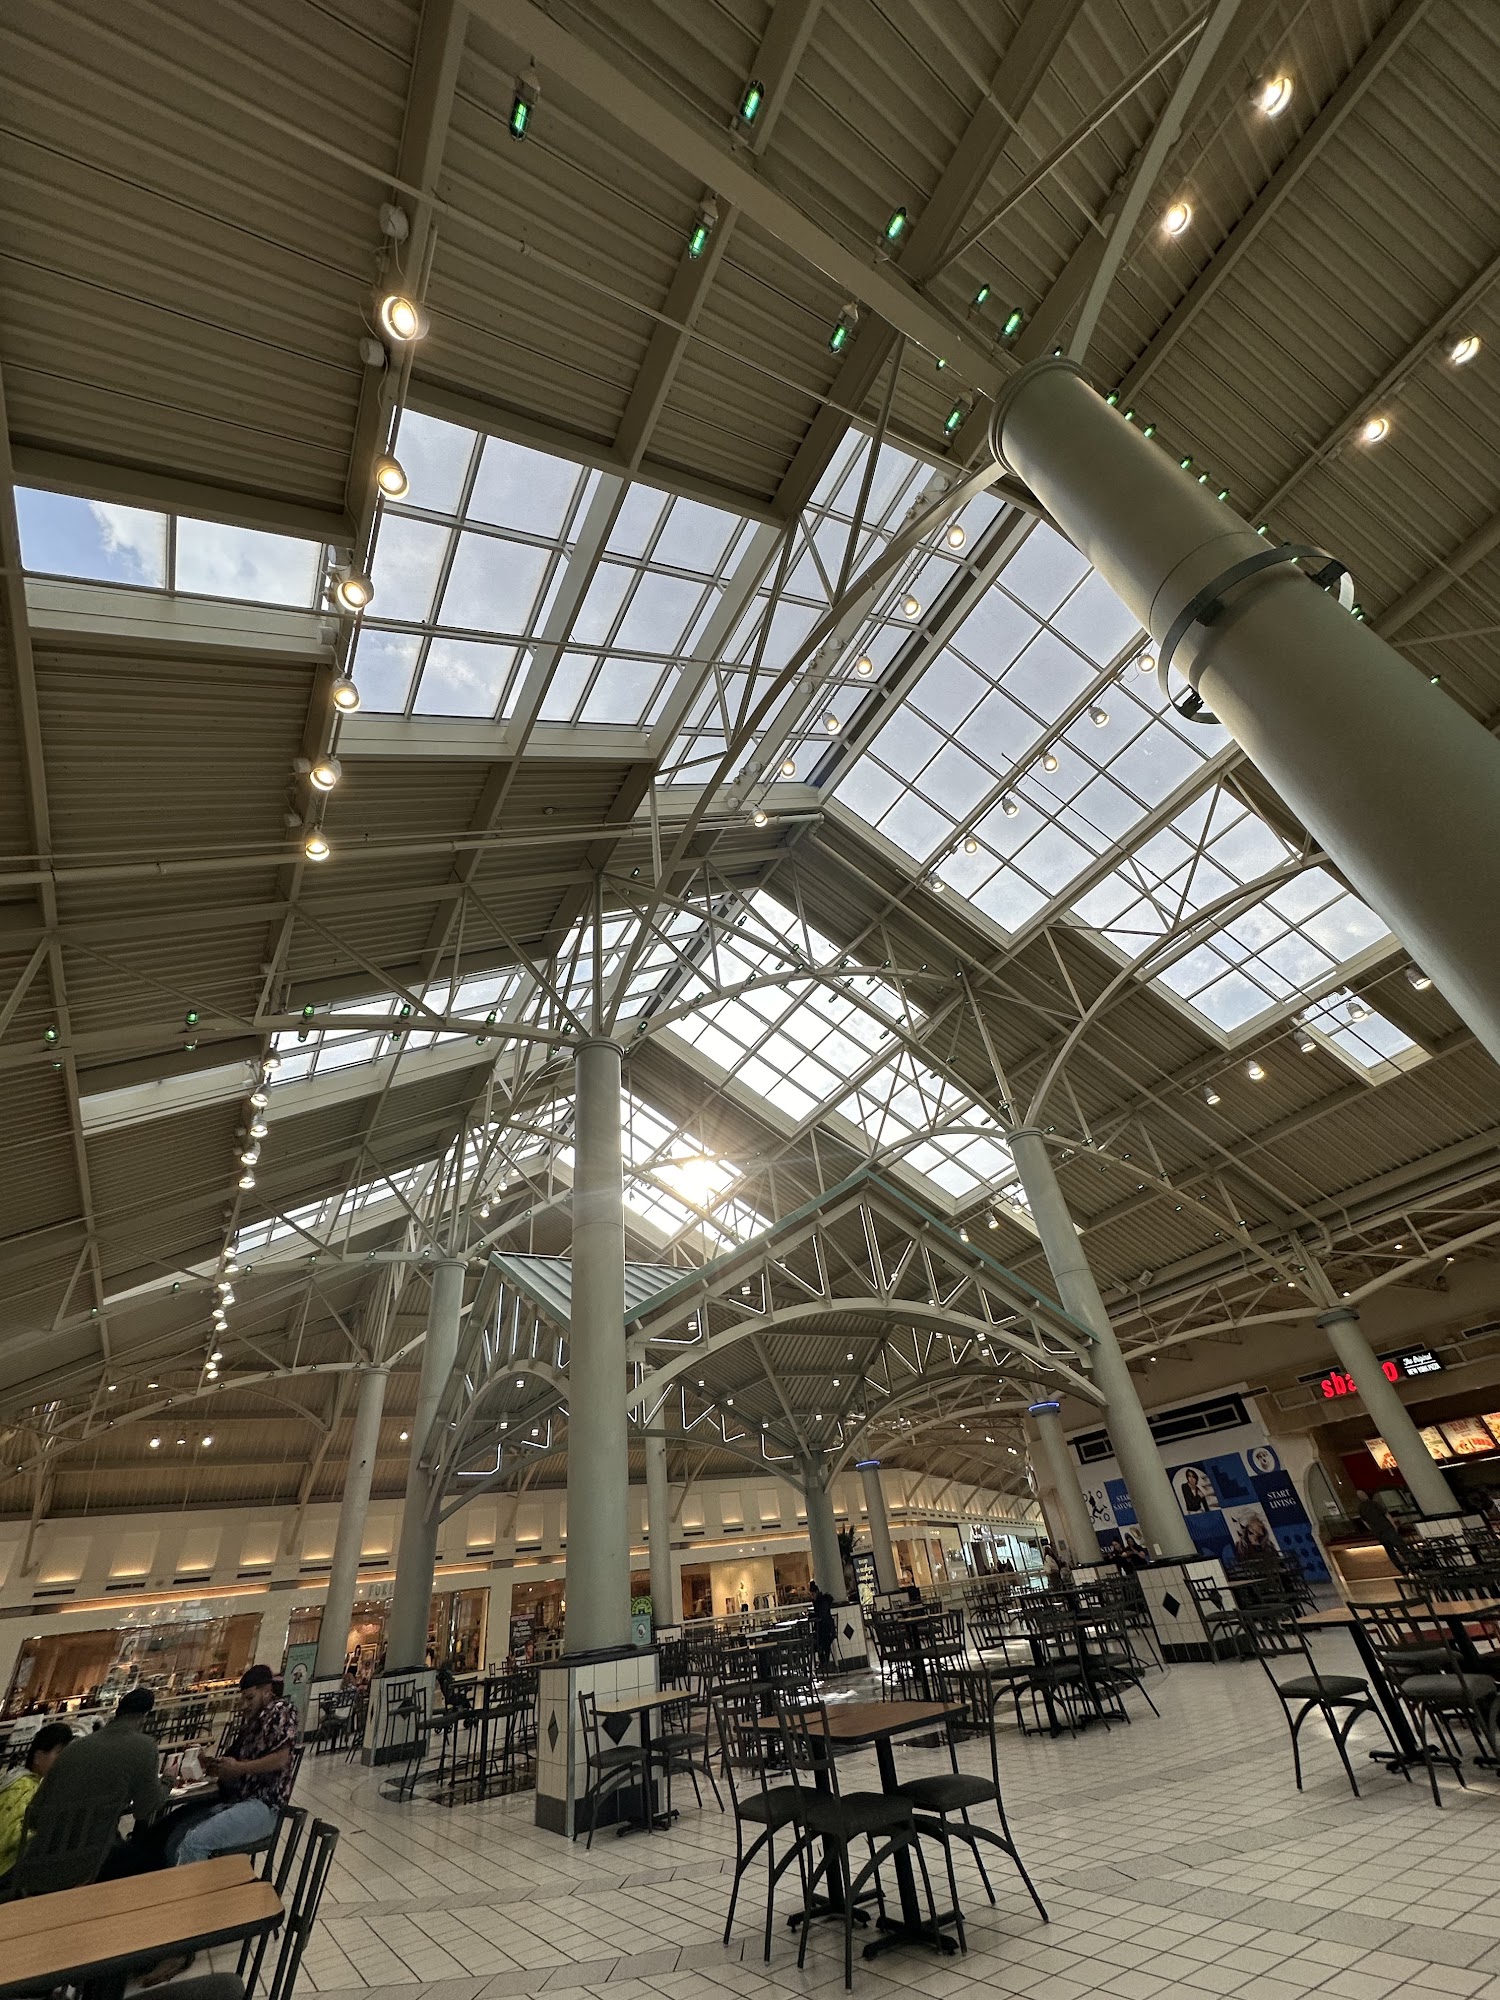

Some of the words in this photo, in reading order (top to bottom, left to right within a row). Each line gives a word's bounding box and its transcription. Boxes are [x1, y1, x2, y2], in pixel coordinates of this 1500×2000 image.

[1406, 1367, 1419, 1376] NEW
[1416, 1365, 1431, 1374] YORK
[1427, 1362, 1442, 1372] PIZZA
[1321, 1361, 1399, 1398] sbao
[1266, 1488, 1291, 1500] START
[1269, 1497, 1297, 1509] LIVING
